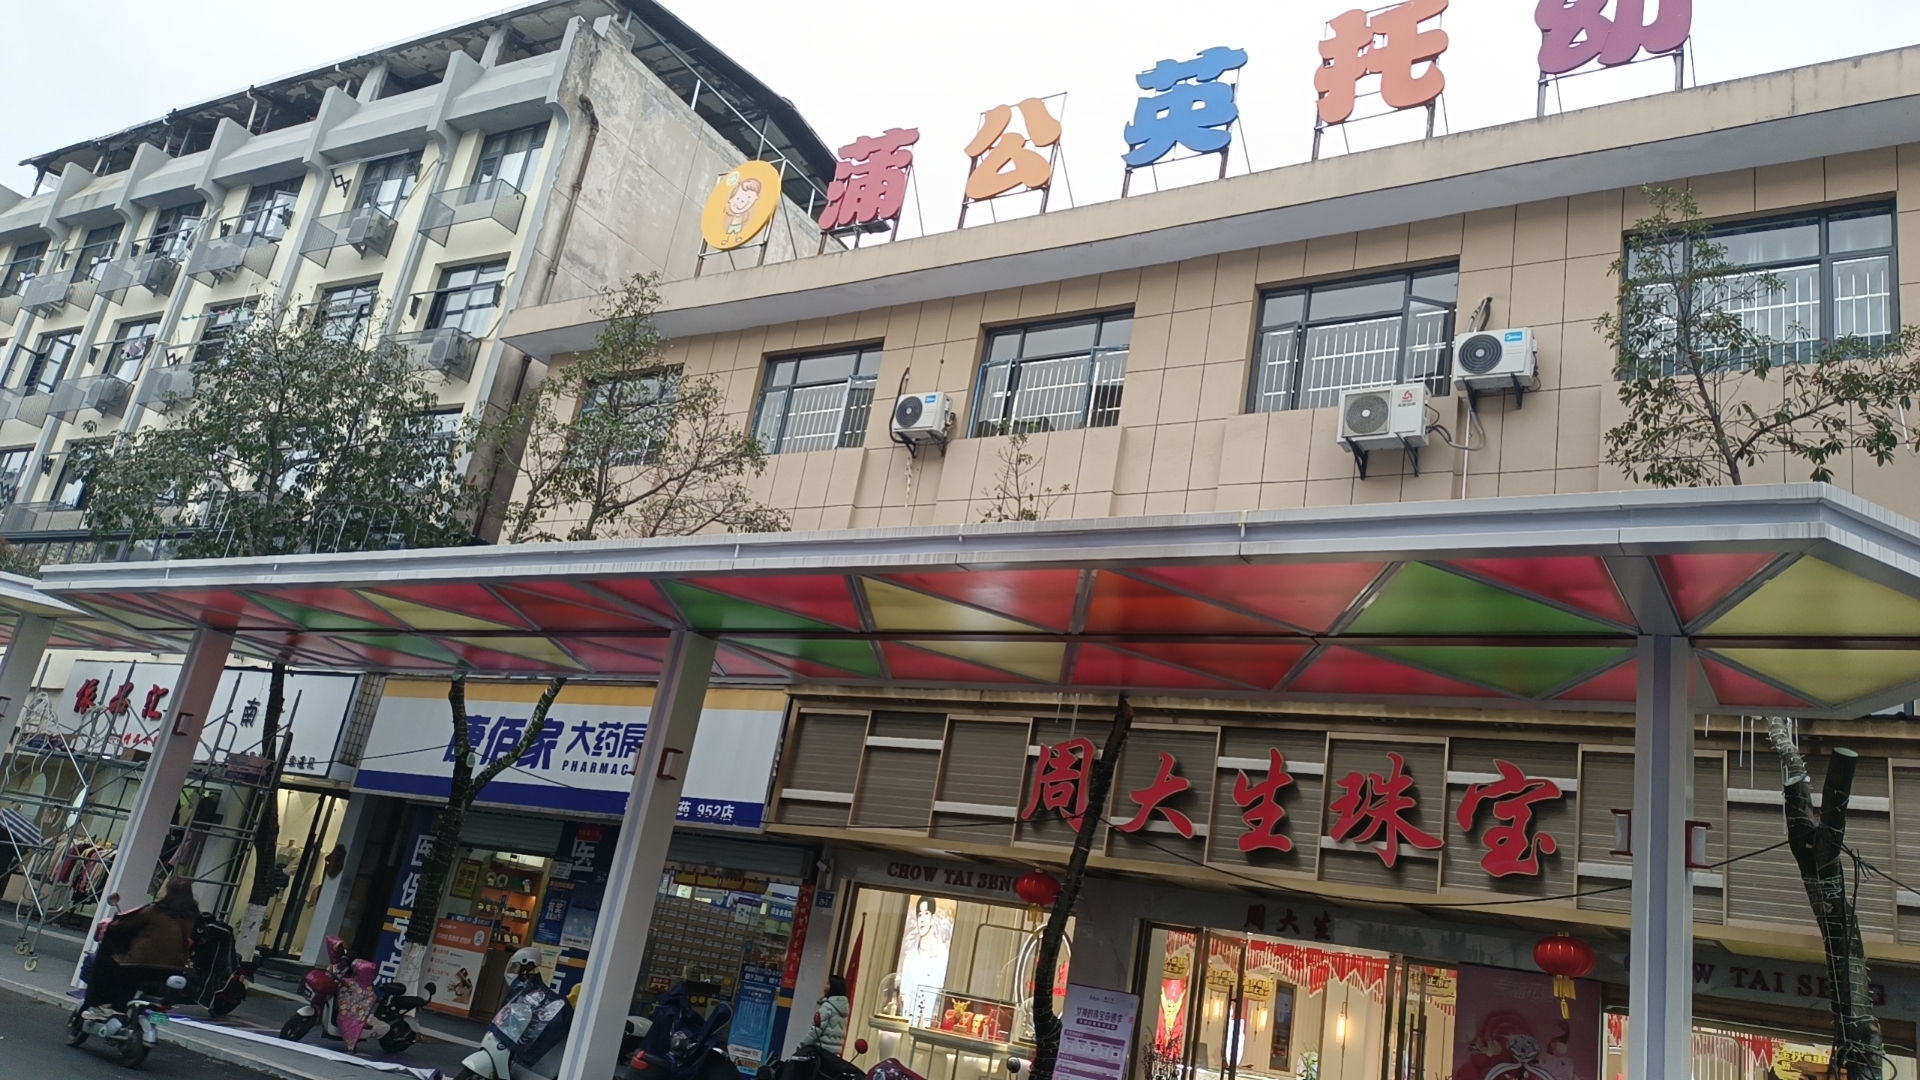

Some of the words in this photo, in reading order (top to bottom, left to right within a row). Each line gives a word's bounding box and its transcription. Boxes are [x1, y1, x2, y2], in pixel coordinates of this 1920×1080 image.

[819, 0, 1692, 231] 蒲公英托幼
[562, 760, 629, 776] PHARMAC
[1021, 737, 1564, 878] 周大生珠宝
[887, 862, 939, 883] CHOW
[943, 868, 973, 888] TAI
[977, 874, 1020, 895] SEN
[1244, 903, 1334, 941] 周大生
[1730, 967, 1785, 993] TAI
